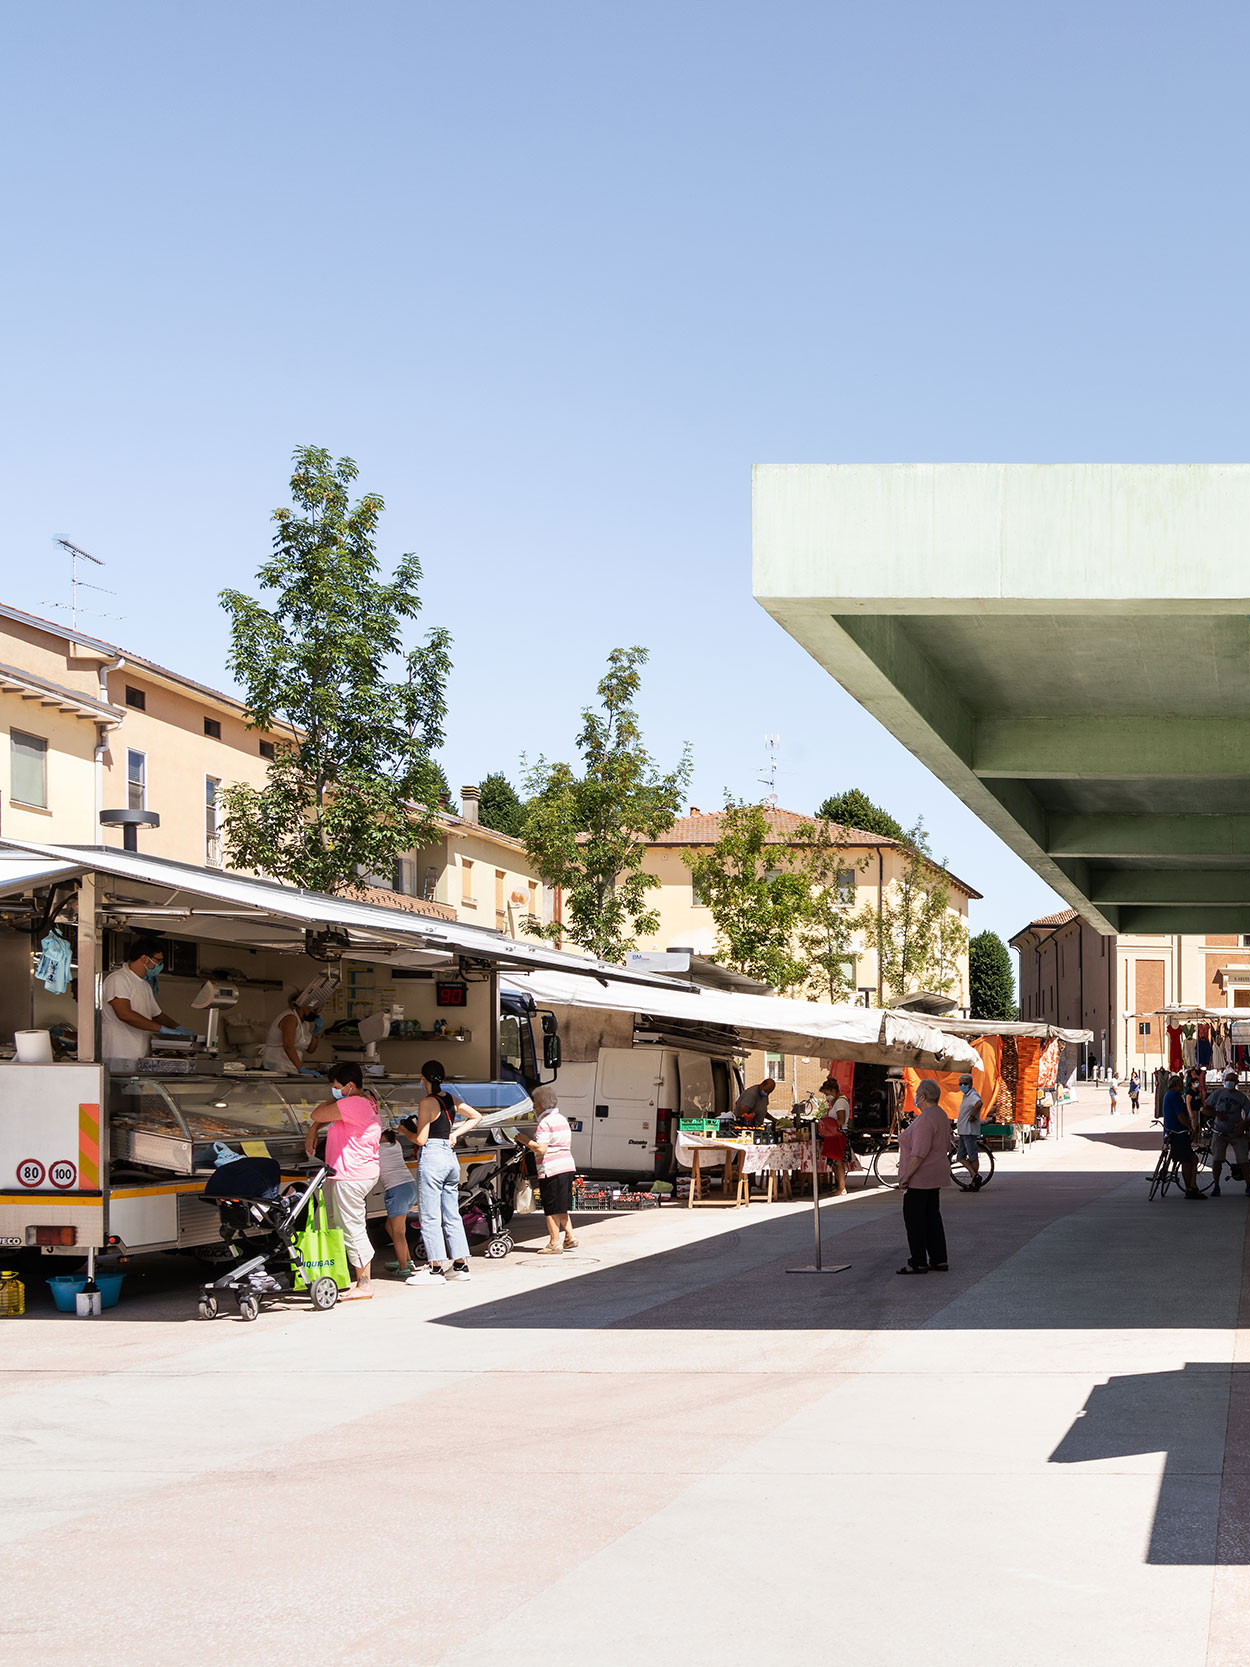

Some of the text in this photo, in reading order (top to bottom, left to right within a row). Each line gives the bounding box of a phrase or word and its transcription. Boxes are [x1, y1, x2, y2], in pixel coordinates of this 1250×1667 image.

[440, 989, 462, 1004] 90
[24, 1166, 39, 1179] 80
[55, 1168, 72, 1180] 100
[302, 1259, 335, 1269] IQUIGAS
